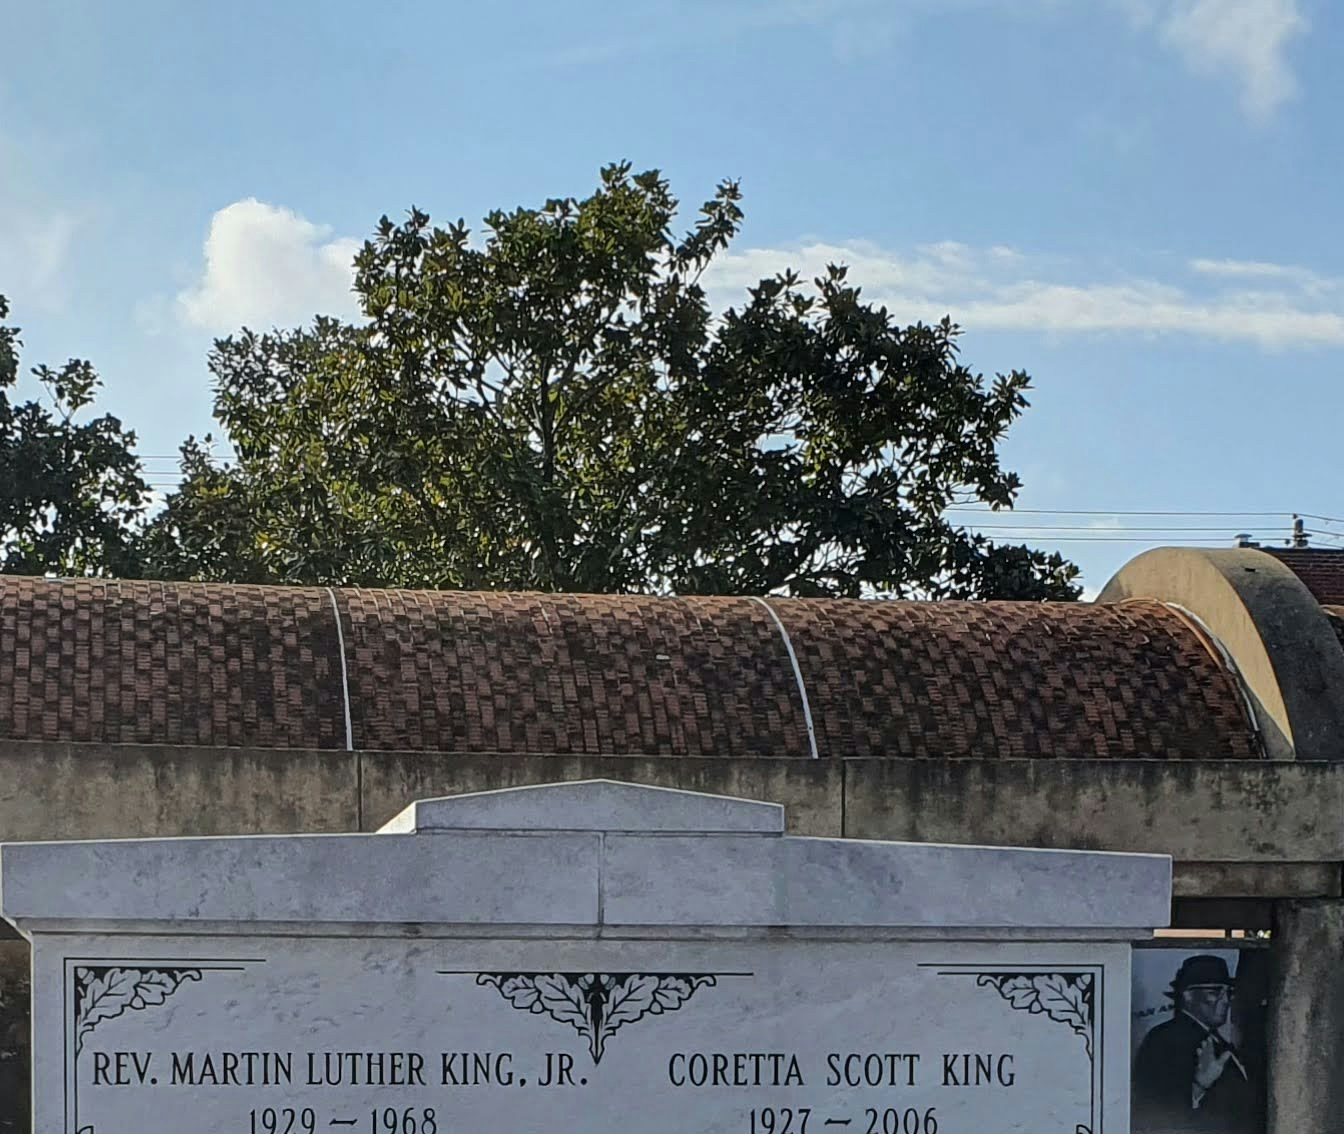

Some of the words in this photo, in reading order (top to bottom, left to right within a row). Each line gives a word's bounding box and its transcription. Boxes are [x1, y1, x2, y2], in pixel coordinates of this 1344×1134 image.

[92, 1051, 159, 1087] REV.
[170, 1052, 294, 1087] MARTIN
[305, 1052, 427, 1087] LUTHER
[440, 1052, 528, 1089] KING,
[537, 1052, 589, 1087] JR.
[668, 1052, 805, 1088] CORETTA
[826, 1052, 922, 1088] SCOTT
[941, 1052, 1016, 1088] KING
